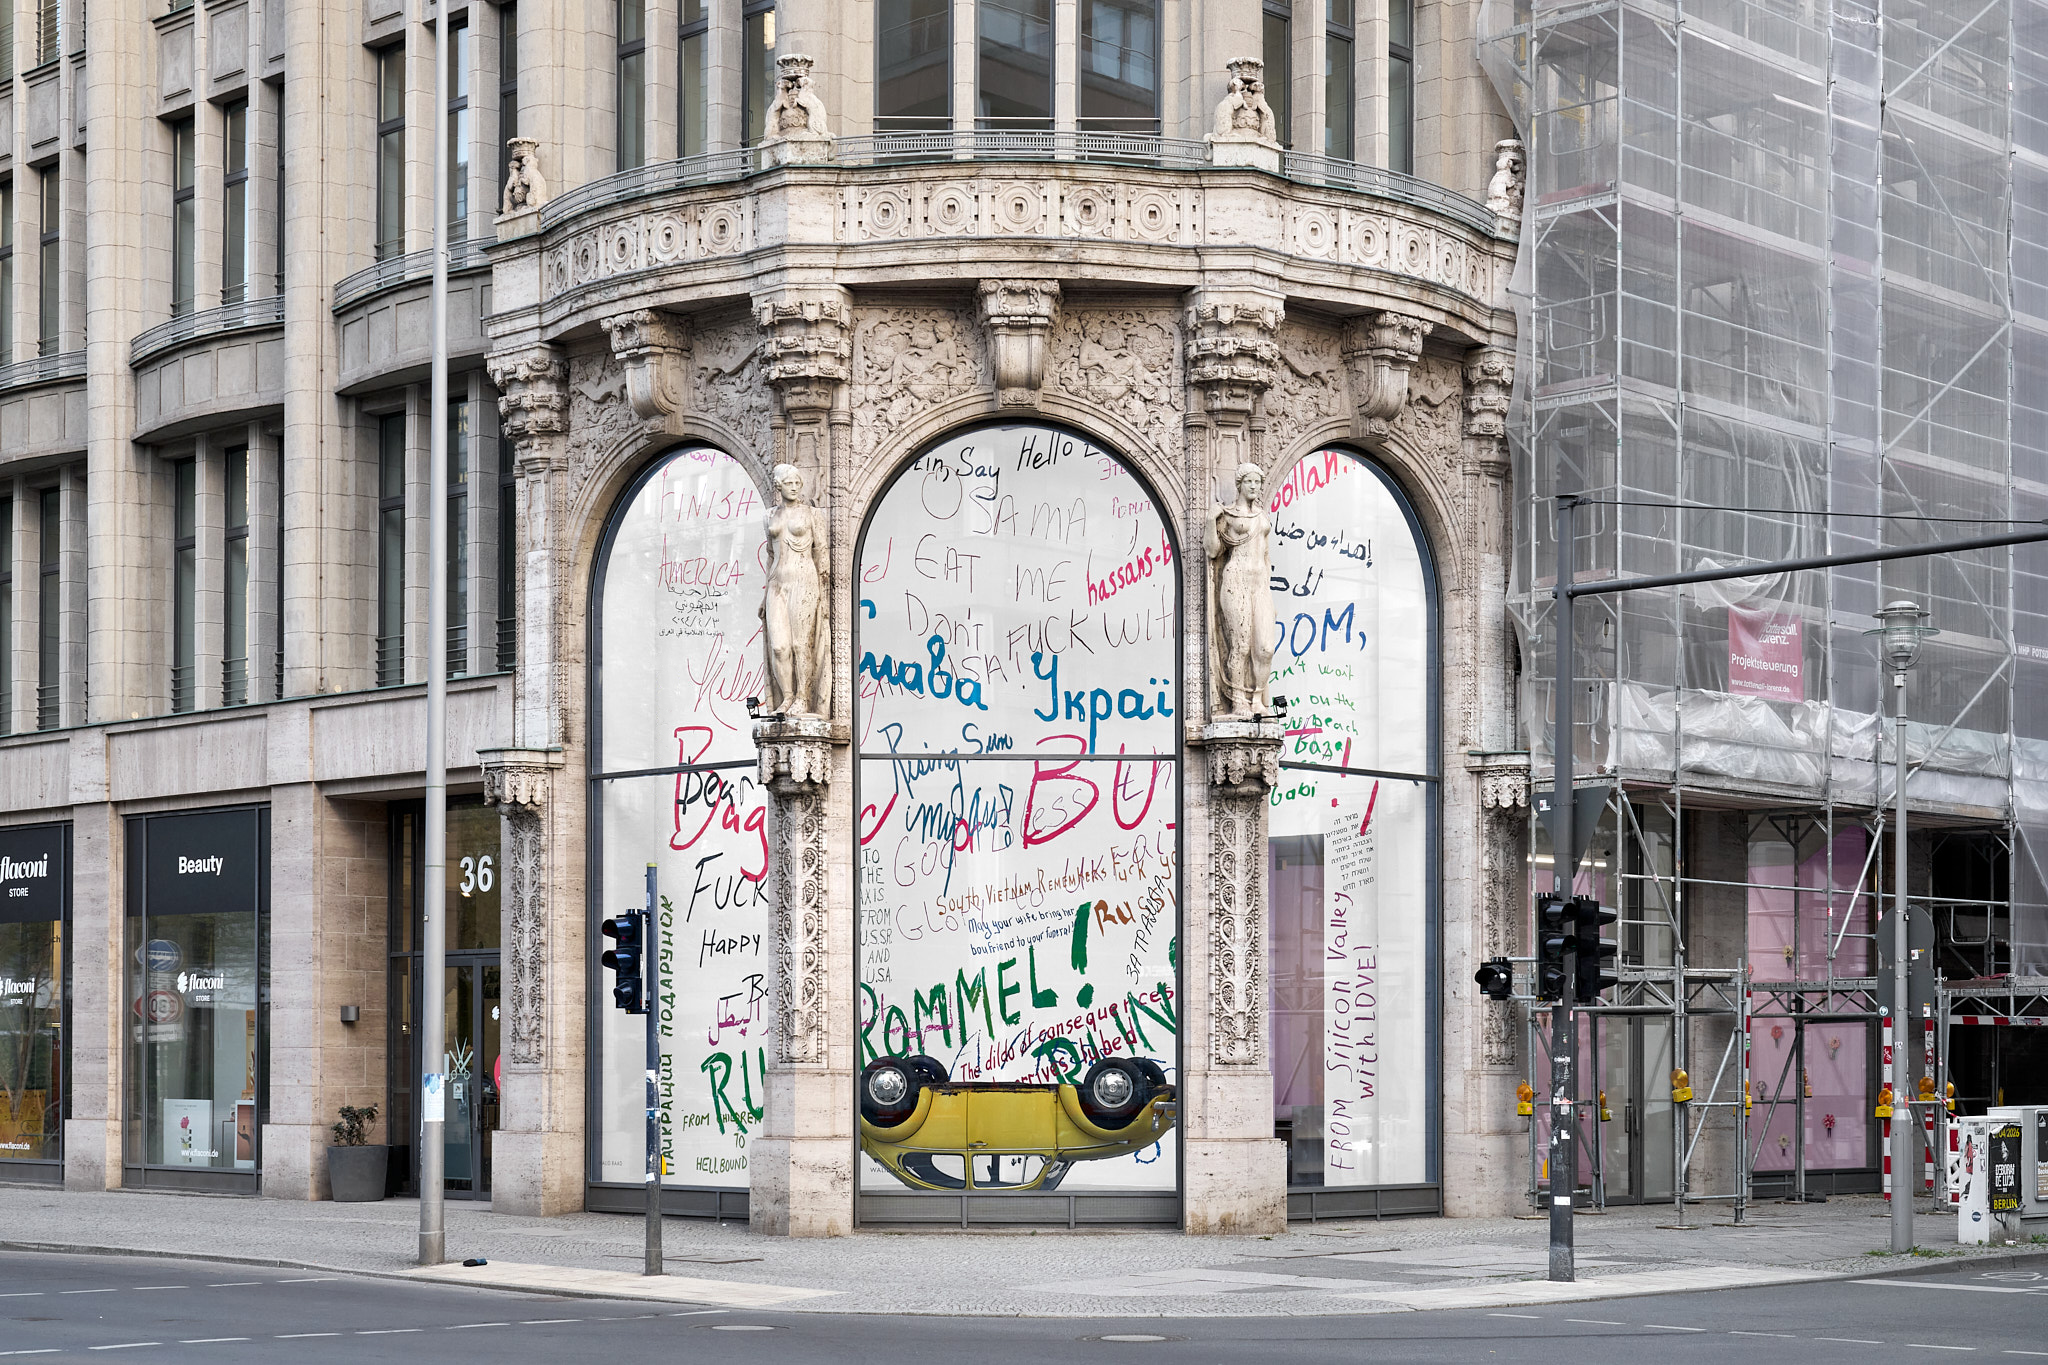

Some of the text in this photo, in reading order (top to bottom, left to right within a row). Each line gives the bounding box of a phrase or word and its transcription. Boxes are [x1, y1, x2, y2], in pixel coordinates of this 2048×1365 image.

[956, 446, 1000, 501] Say
[1017, 431, 1074, 471] Hello
[658, 532, 744, 588] AMERICA
[1016, 560, 1071, 603] ME
[1006, 608, 1094, 661] FUCK
[1731, 652, 1799, 677] Projektsteuerung
[0, 853, 48, 883] flaconi
[178, 855, 224, 875] Beauty
[459, 854, 495, 893] 36
[8, 887, 29, 897] STORE
[968, 917, 993, 940] May
[992, 916, 1013, 935] your
[1015, 912, 1038, 926] wife
[1038, 908, 1063, 921] bring
[700, 928, 761, 968] Happy
[4, 976, 35, 996] flaconi
[188, 972, 224, 992] flaconi
[683, 1112, 710, 1131] FROM
[1993, 1198, 2018, 1209] BERLIN
